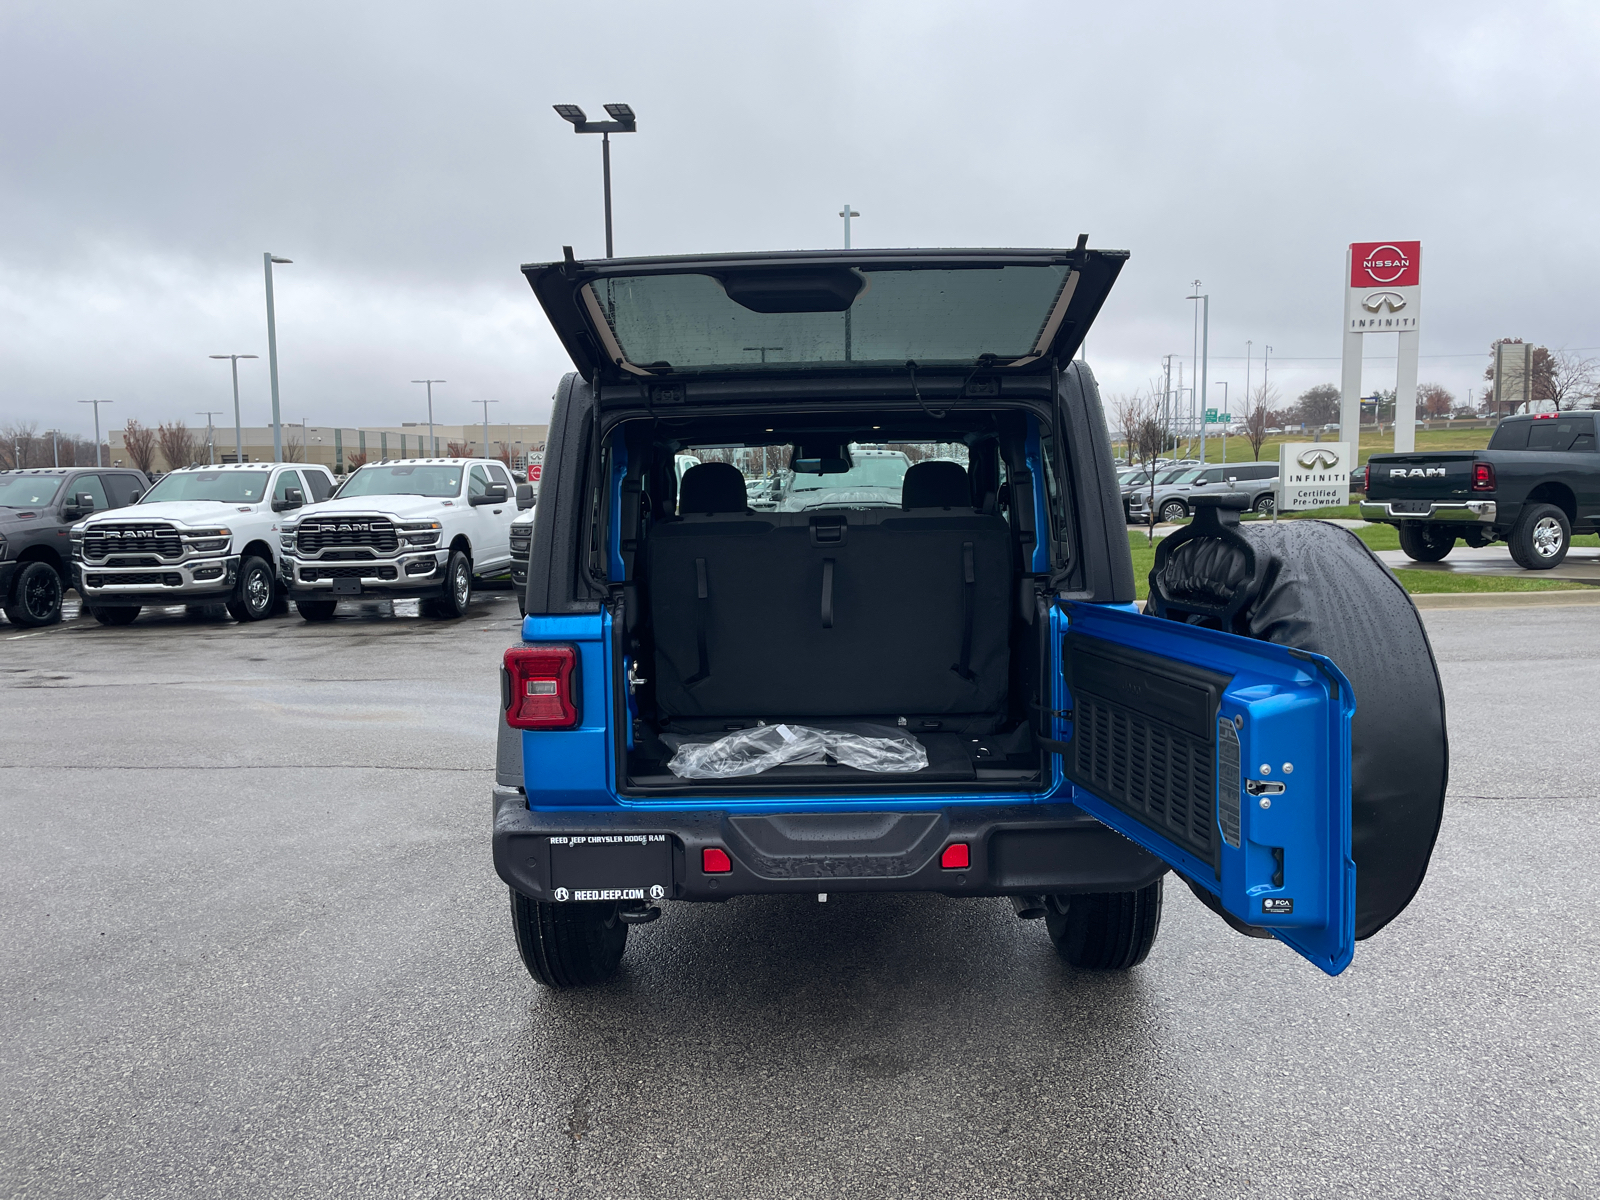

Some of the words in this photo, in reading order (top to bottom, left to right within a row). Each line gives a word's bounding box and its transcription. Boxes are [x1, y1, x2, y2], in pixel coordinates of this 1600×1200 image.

[1363, 259, 1409, 268] NISSAN
[1352, 318, 1415, 327] INFINITI
[1389, 467, 1446, 478] RAM
[1289, 474, 1346, 482] INFINITI
[1297, 489, 1337, 498] Certified
[1292, 497, 1341, 506] Pre-Owned
[320, 523, 369, 532] RAM
[105, 530, 153, 539] RAM
[550, 836, 568, 844] REED
[570, 836, 586, 844] JEEP
[587, 835, 623, 844] CHRYSLER
[624, 834, 647, 843] DODGE
[648, 834, 665, 842] RAM
[574, 889, 644, 901] REEDJEEP.COM
